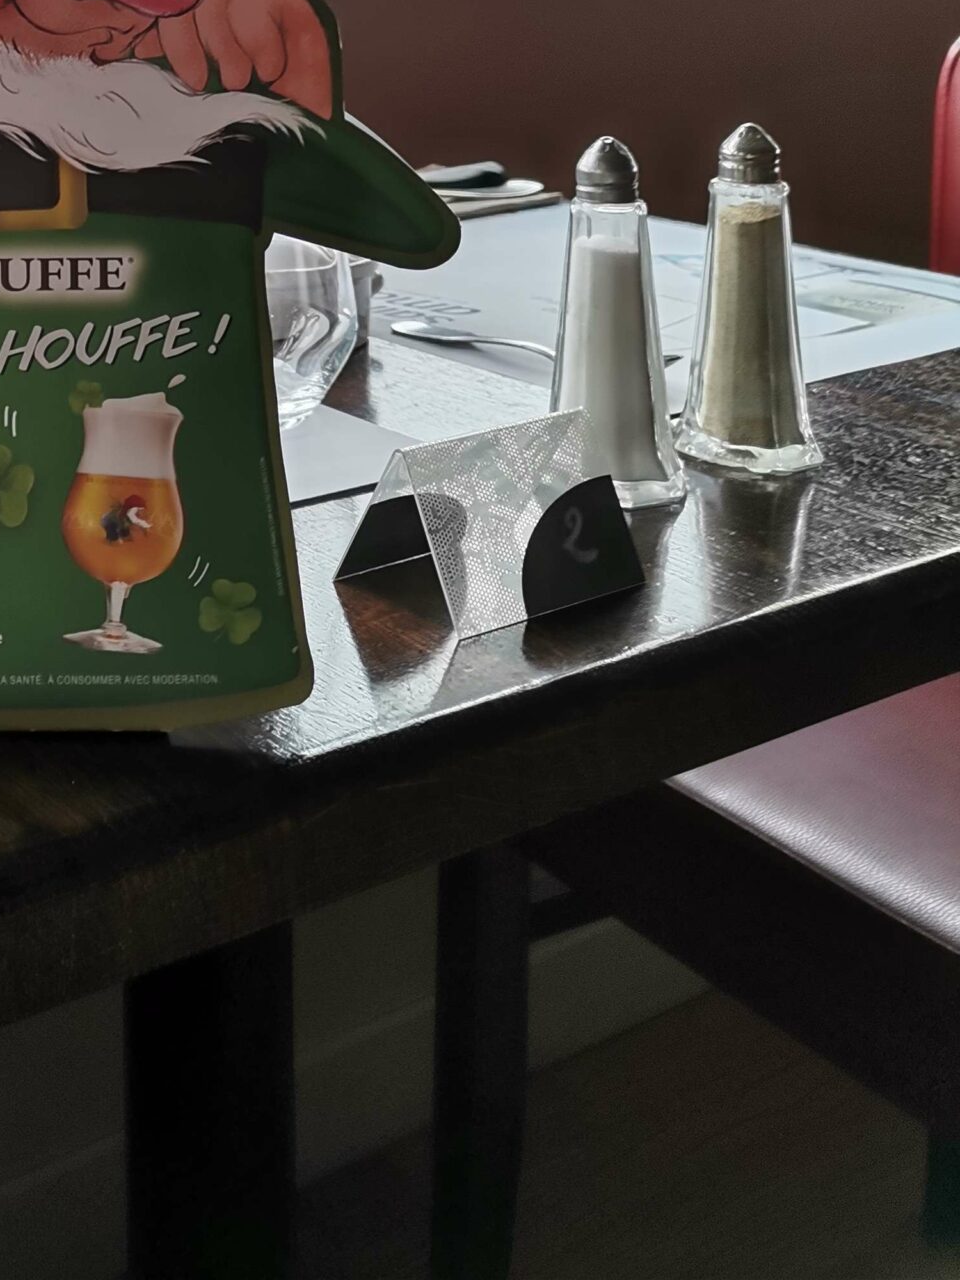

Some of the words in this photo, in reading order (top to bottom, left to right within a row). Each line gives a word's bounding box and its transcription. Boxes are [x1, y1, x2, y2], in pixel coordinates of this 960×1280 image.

[563, 507, 599, 563] 2
[56, 674, 121, 686] CONSOMMER
[124, 674, 151, 686] AVEC
